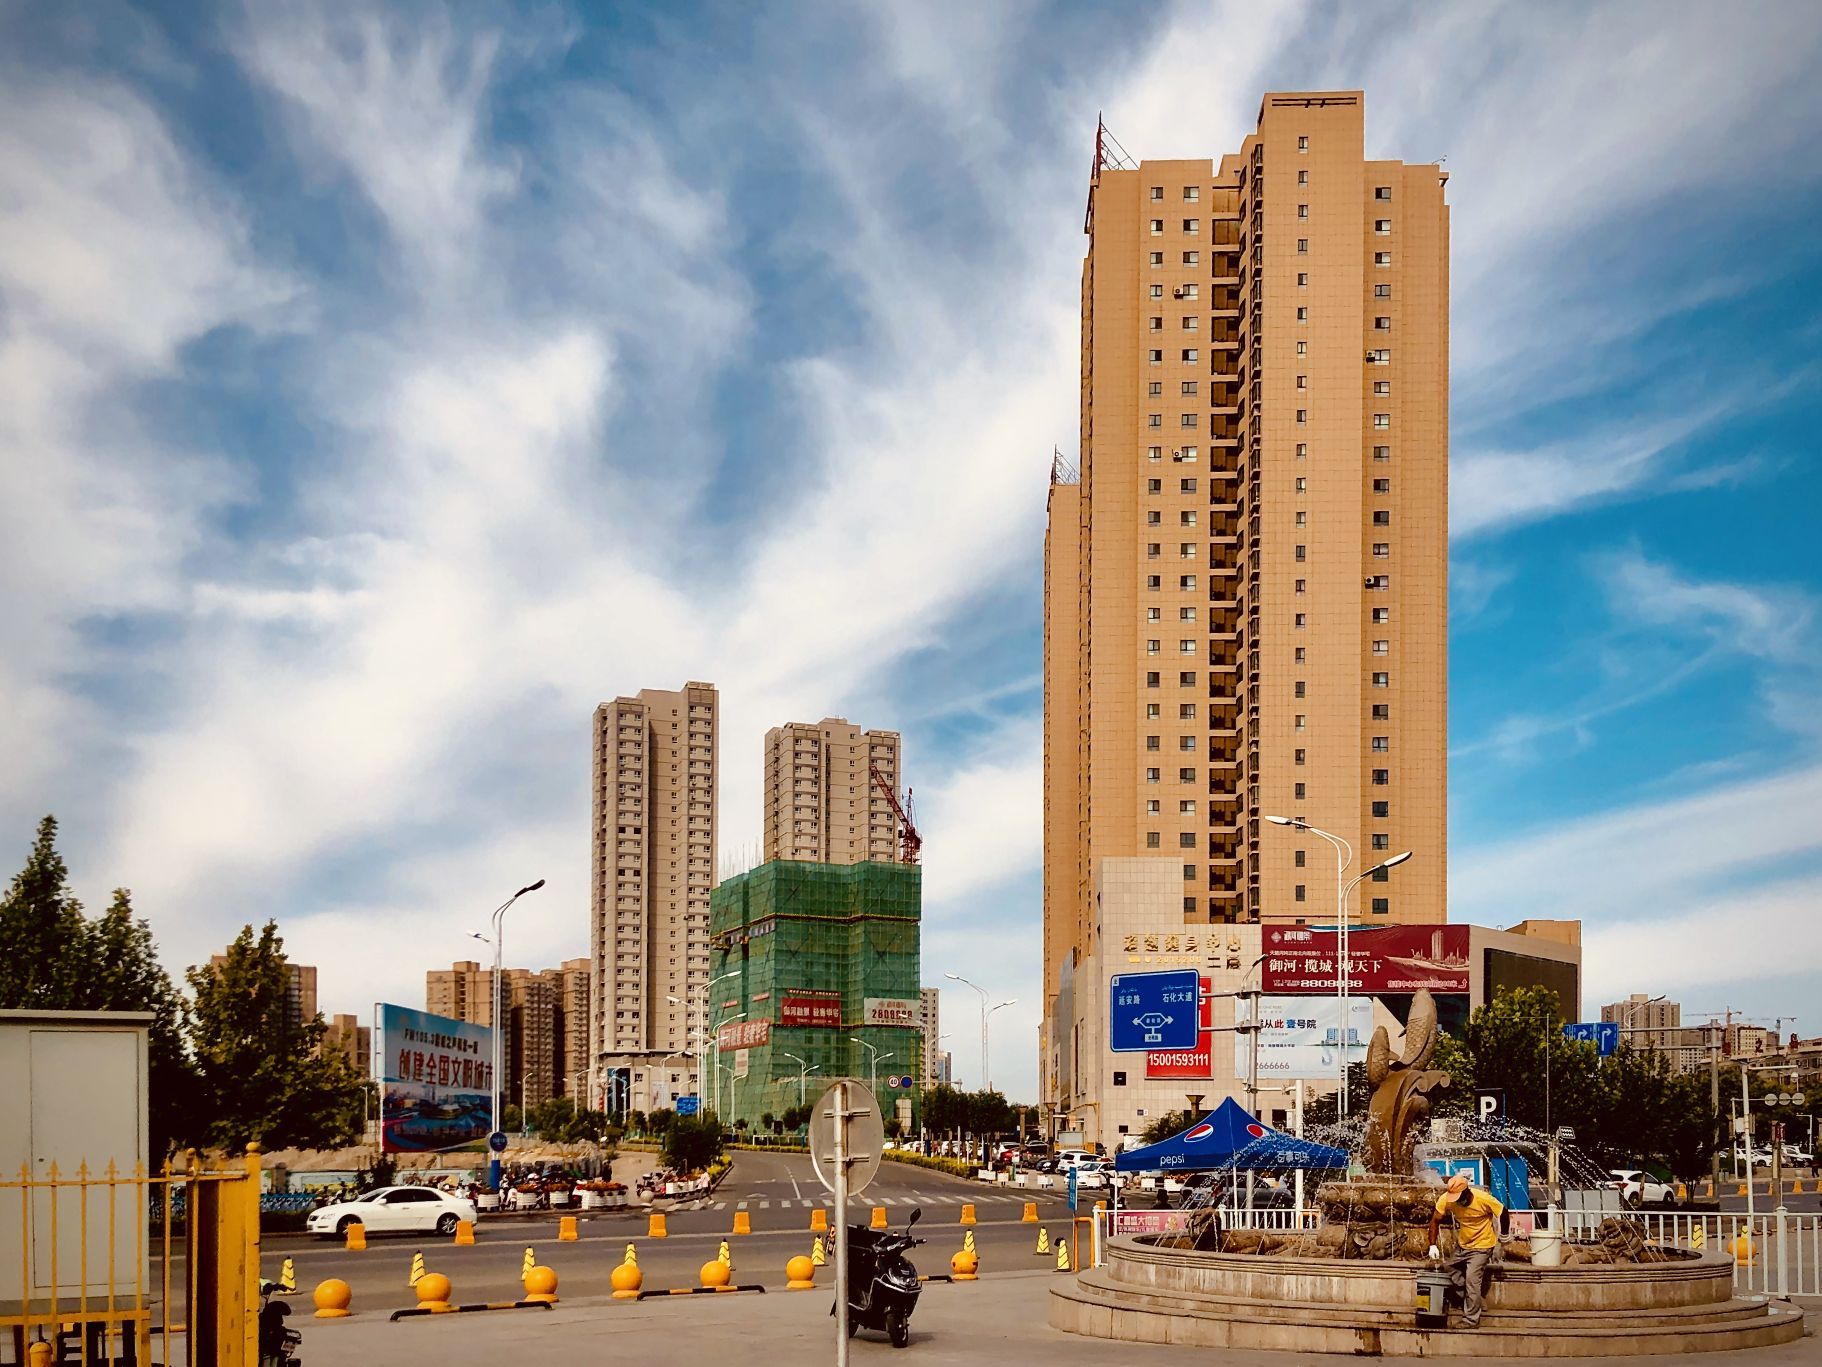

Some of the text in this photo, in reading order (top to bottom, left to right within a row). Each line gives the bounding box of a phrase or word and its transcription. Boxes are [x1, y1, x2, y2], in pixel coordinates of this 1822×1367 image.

[1162, 991, 1193, 1003] 石化大道
[1148, 1053, 1209, 1066] 15001593111
[1480, 1096, 1498, 1122] P
[1160, 1153, 1185, 1166] pepsi
